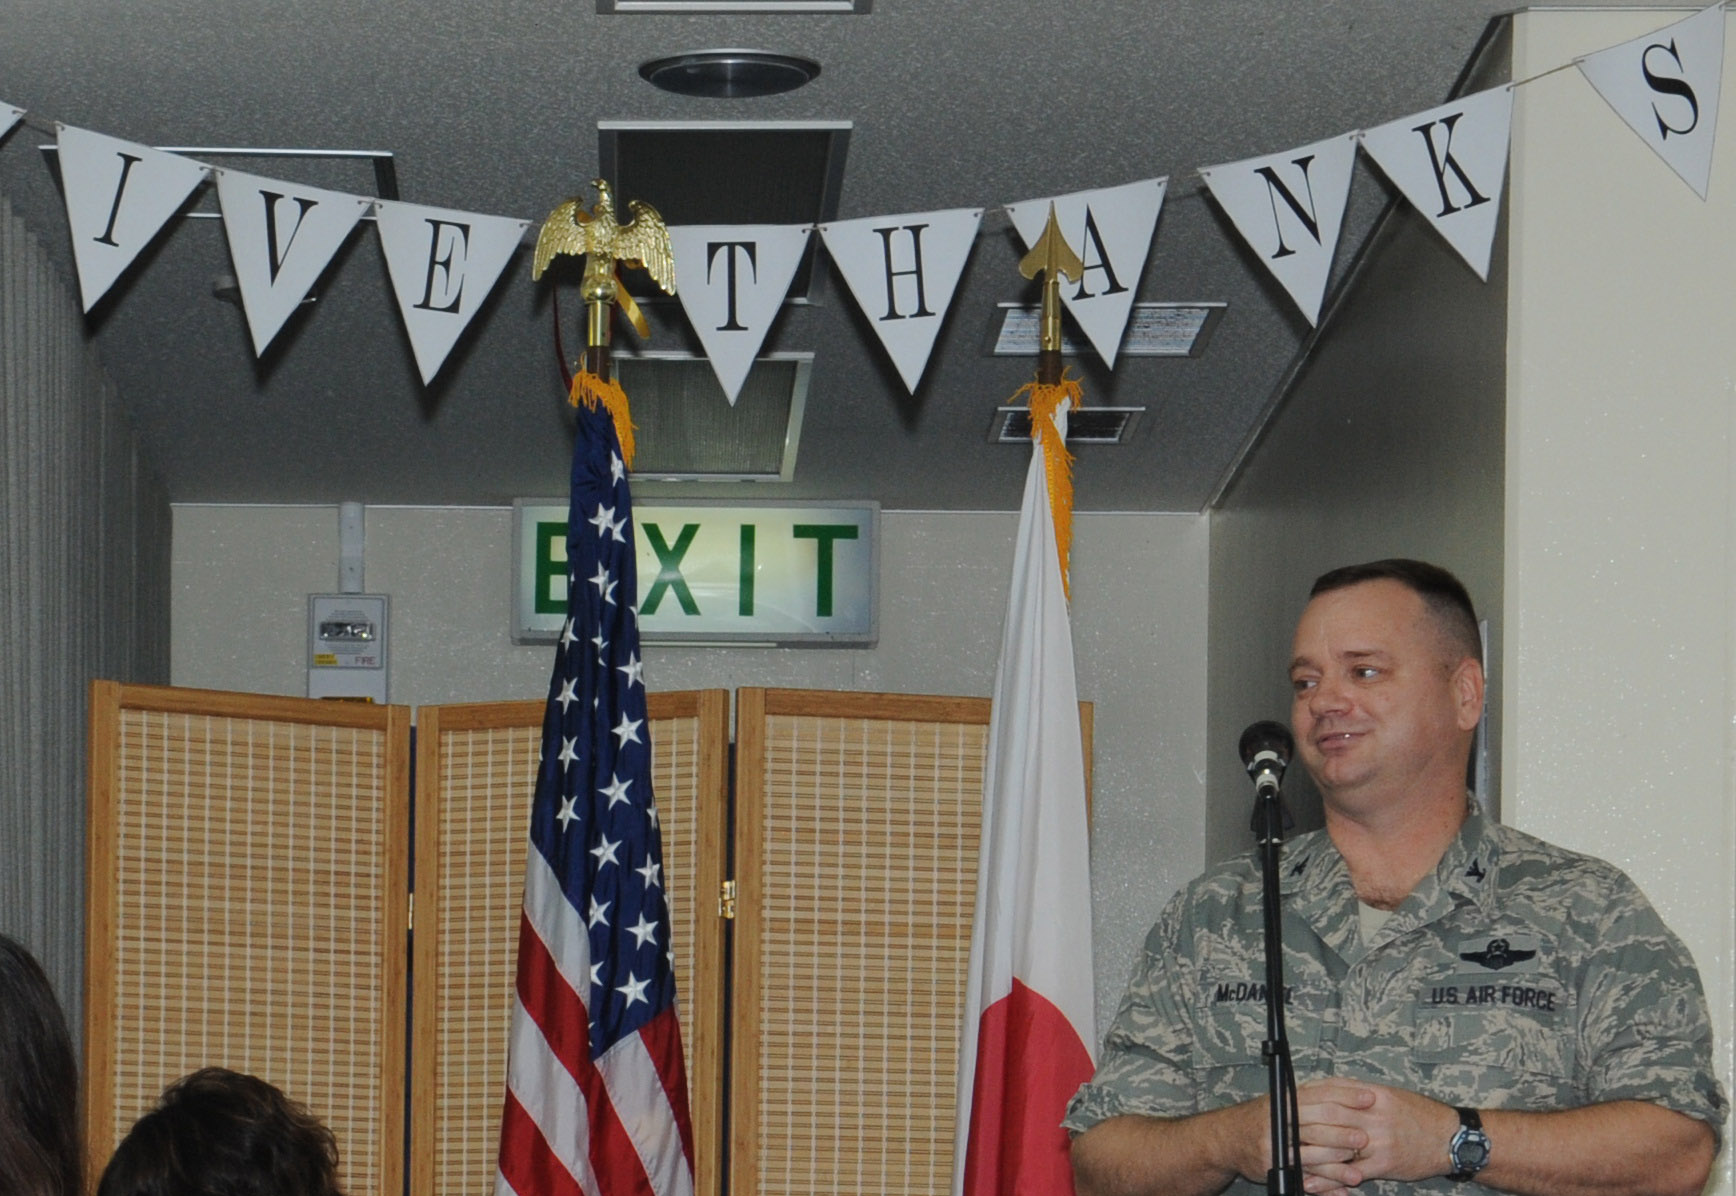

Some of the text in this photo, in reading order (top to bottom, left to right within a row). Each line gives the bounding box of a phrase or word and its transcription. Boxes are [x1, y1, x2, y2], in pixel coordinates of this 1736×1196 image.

[705, 37, 1702, 333] THANKS
[534, 520, 859, 618] EXIT
[354, 655, 377, 665] FIRE
[1215, 982, 1294, 1006] McDANL
[1466, 985, 1496, 1004] AIR
[1501, 986, 1556, 1012] FORCE
